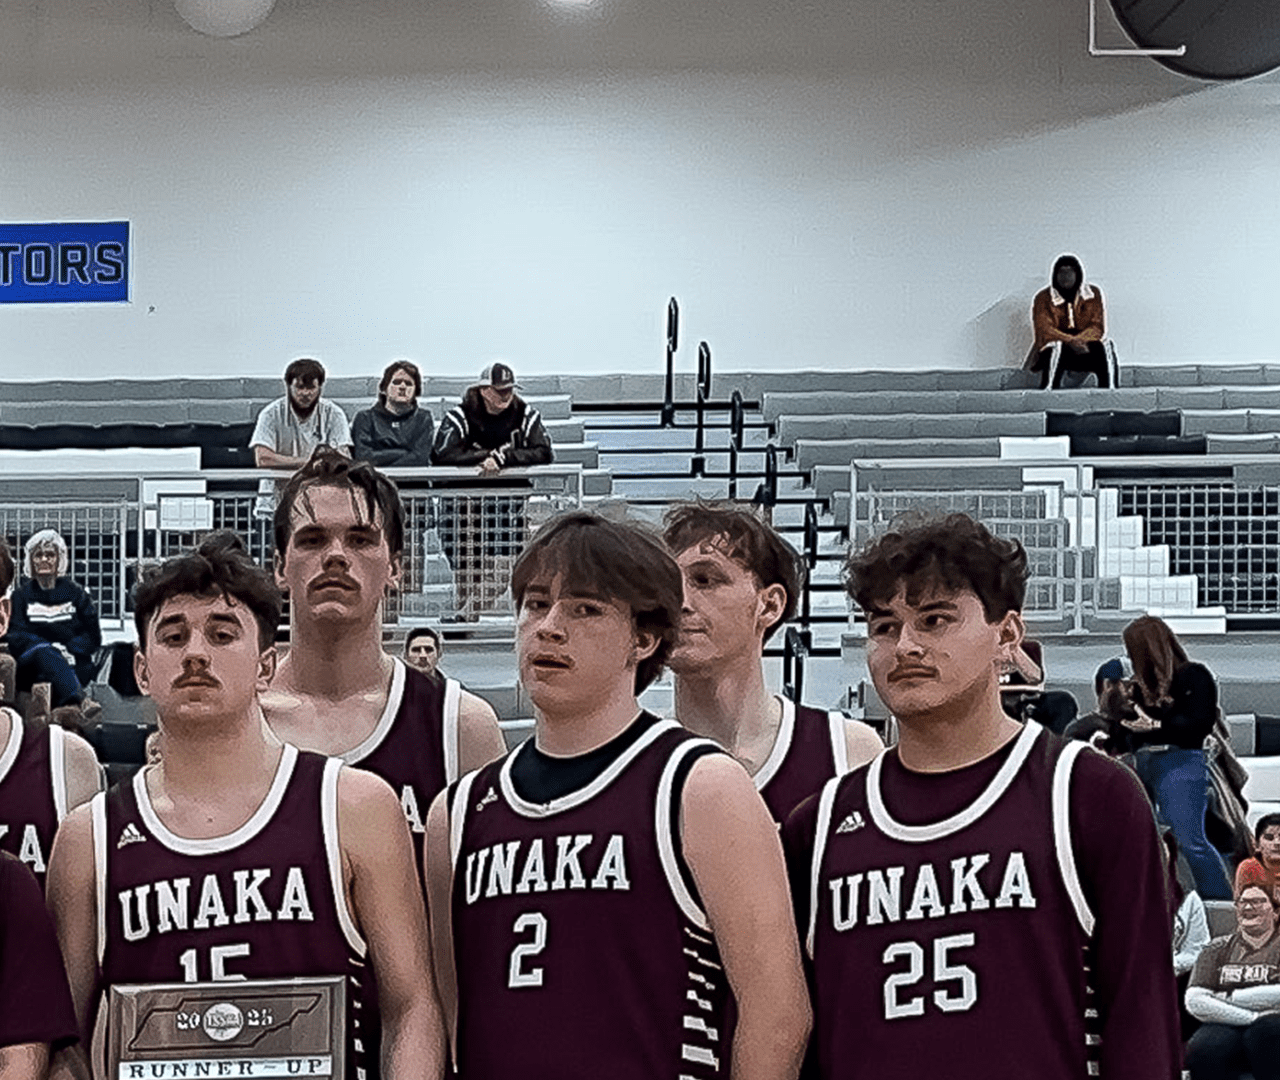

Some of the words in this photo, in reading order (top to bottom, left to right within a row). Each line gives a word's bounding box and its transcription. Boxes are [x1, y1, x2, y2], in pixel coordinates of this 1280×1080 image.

[119, 868, 313, 941] UNAKA
[466, 834, 630, 905] UNAKA
[829, 852, 1036, 932] UNAKA
[180, 943, 250, 982] 15
[509, 913, 547, 988] 2
[883, 933, 977, 1019] 25
[177, 1013, 200, 1030] 20
[247, 1009, 273, 1026] 25
